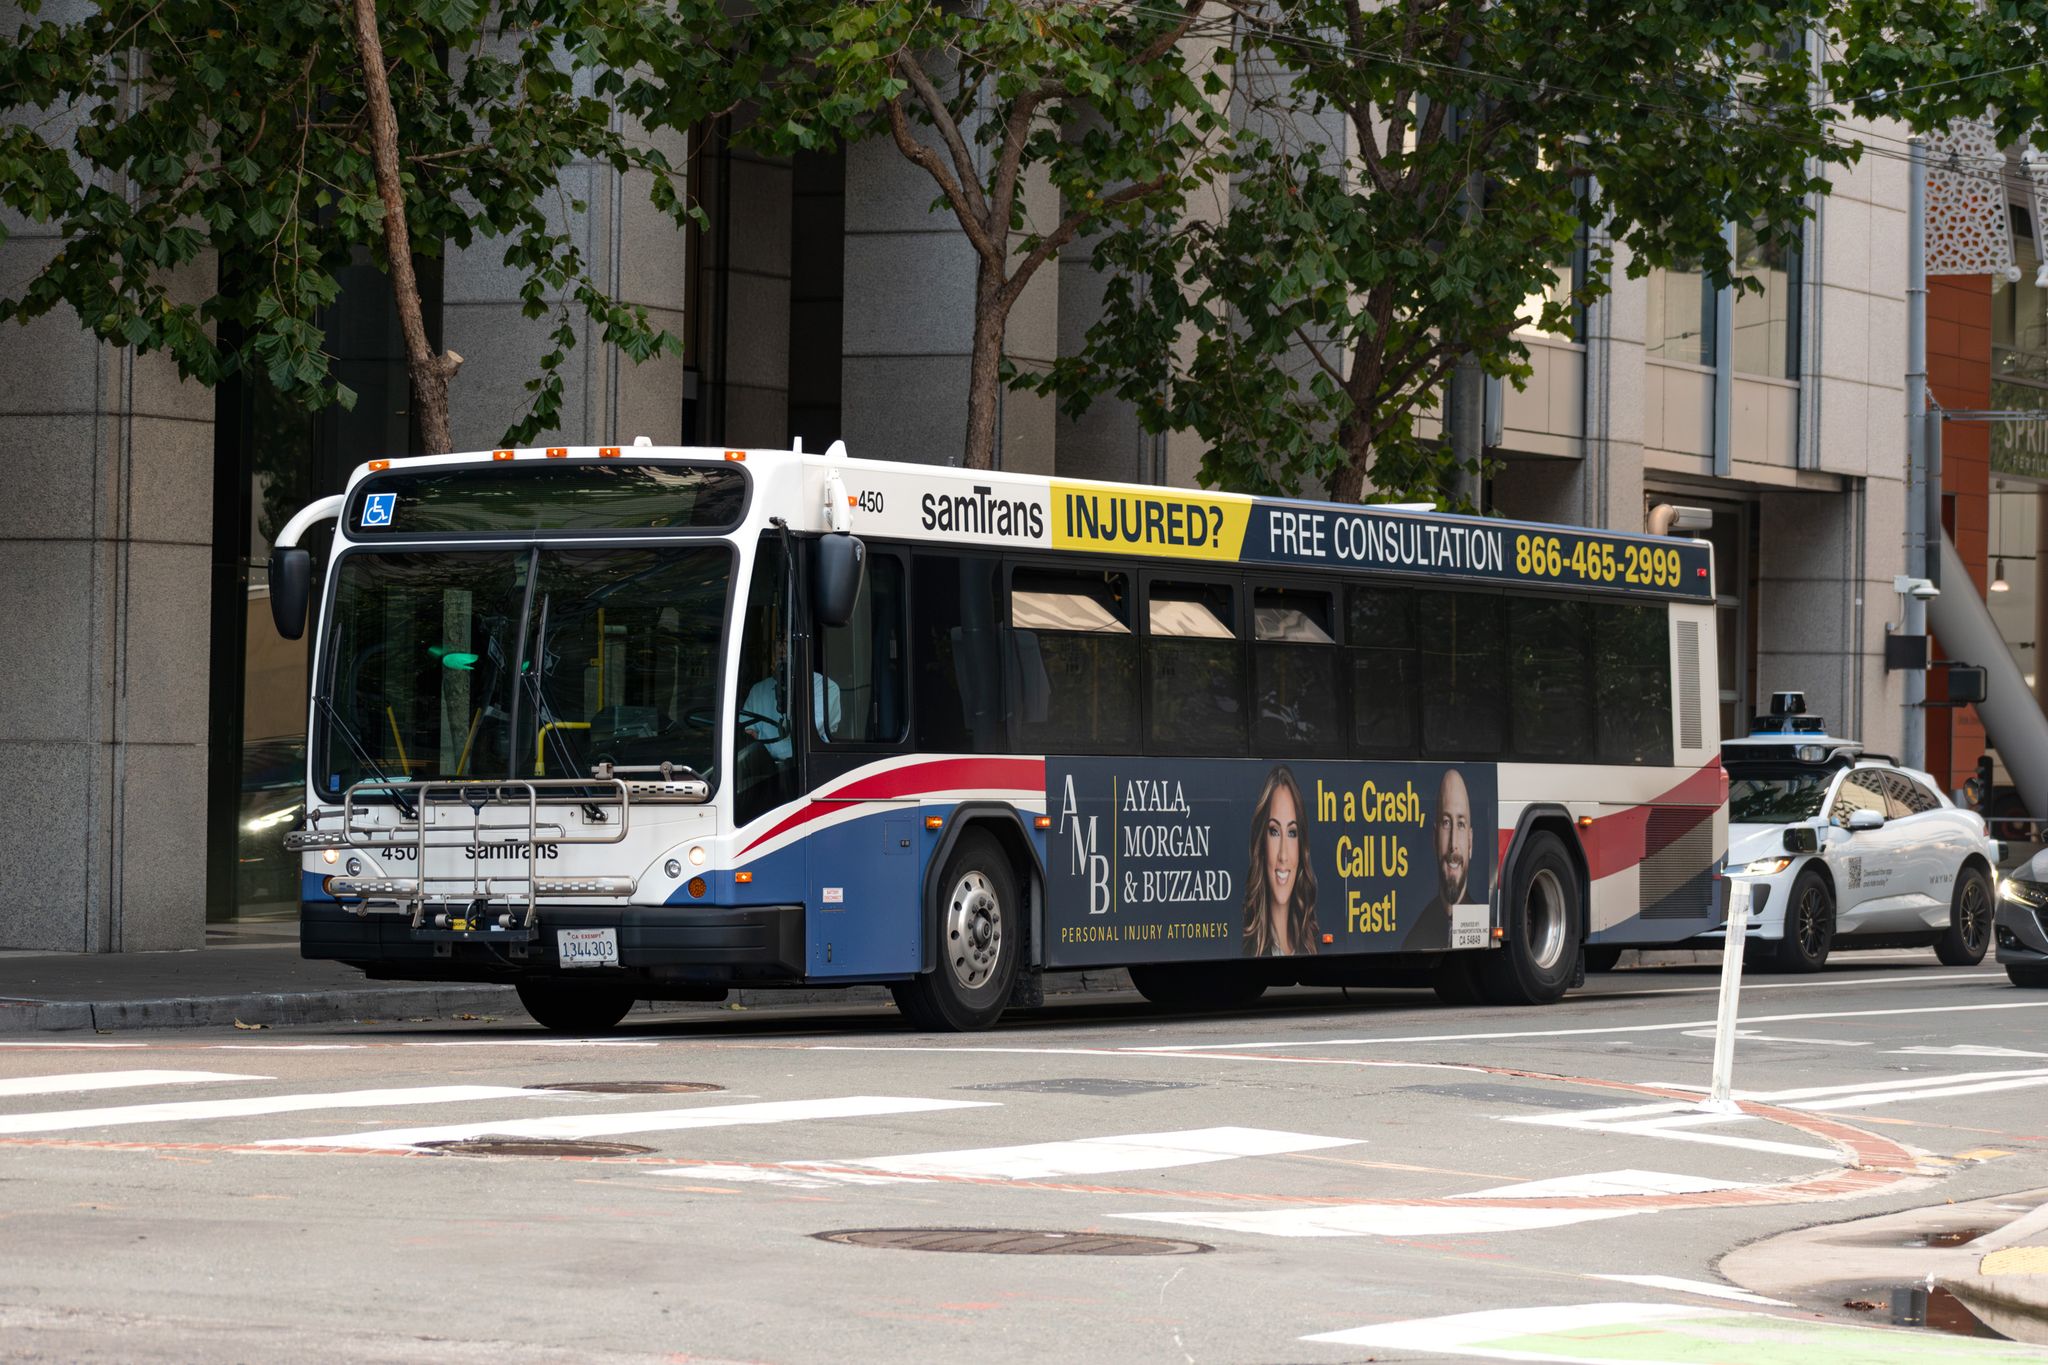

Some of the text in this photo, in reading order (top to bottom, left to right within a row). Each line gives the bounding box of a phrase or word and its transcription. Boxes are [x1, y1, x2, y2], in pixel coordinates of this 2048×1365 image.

[858, 491, 884, 514] 450
[922, 486, 1044, 539] samTrans
[1065, 494, 1224, 548] INJURED?
[1270, 511, 1682, 588] FREE CONSULTATION 866-465-2999
[1123, 780, 1191, 818] AYALA,
[1317, 779, 1426, 828] In a Crash,
[381, 847, 418, 861] 450
[1123, 825, 1211, 857] MORGAN
[1336, 835, 1409, 879] Call Us
[1123, 870, 1232, 903] & BUZZARD
[1348, 890, 1397, 933] Fast!
[563, 941, 613, 957] 1344303
[1061, 922, 1229, 943] PERSONAL INJURY ATTORNEYS
[1459, 935, 1466, 945] CA
